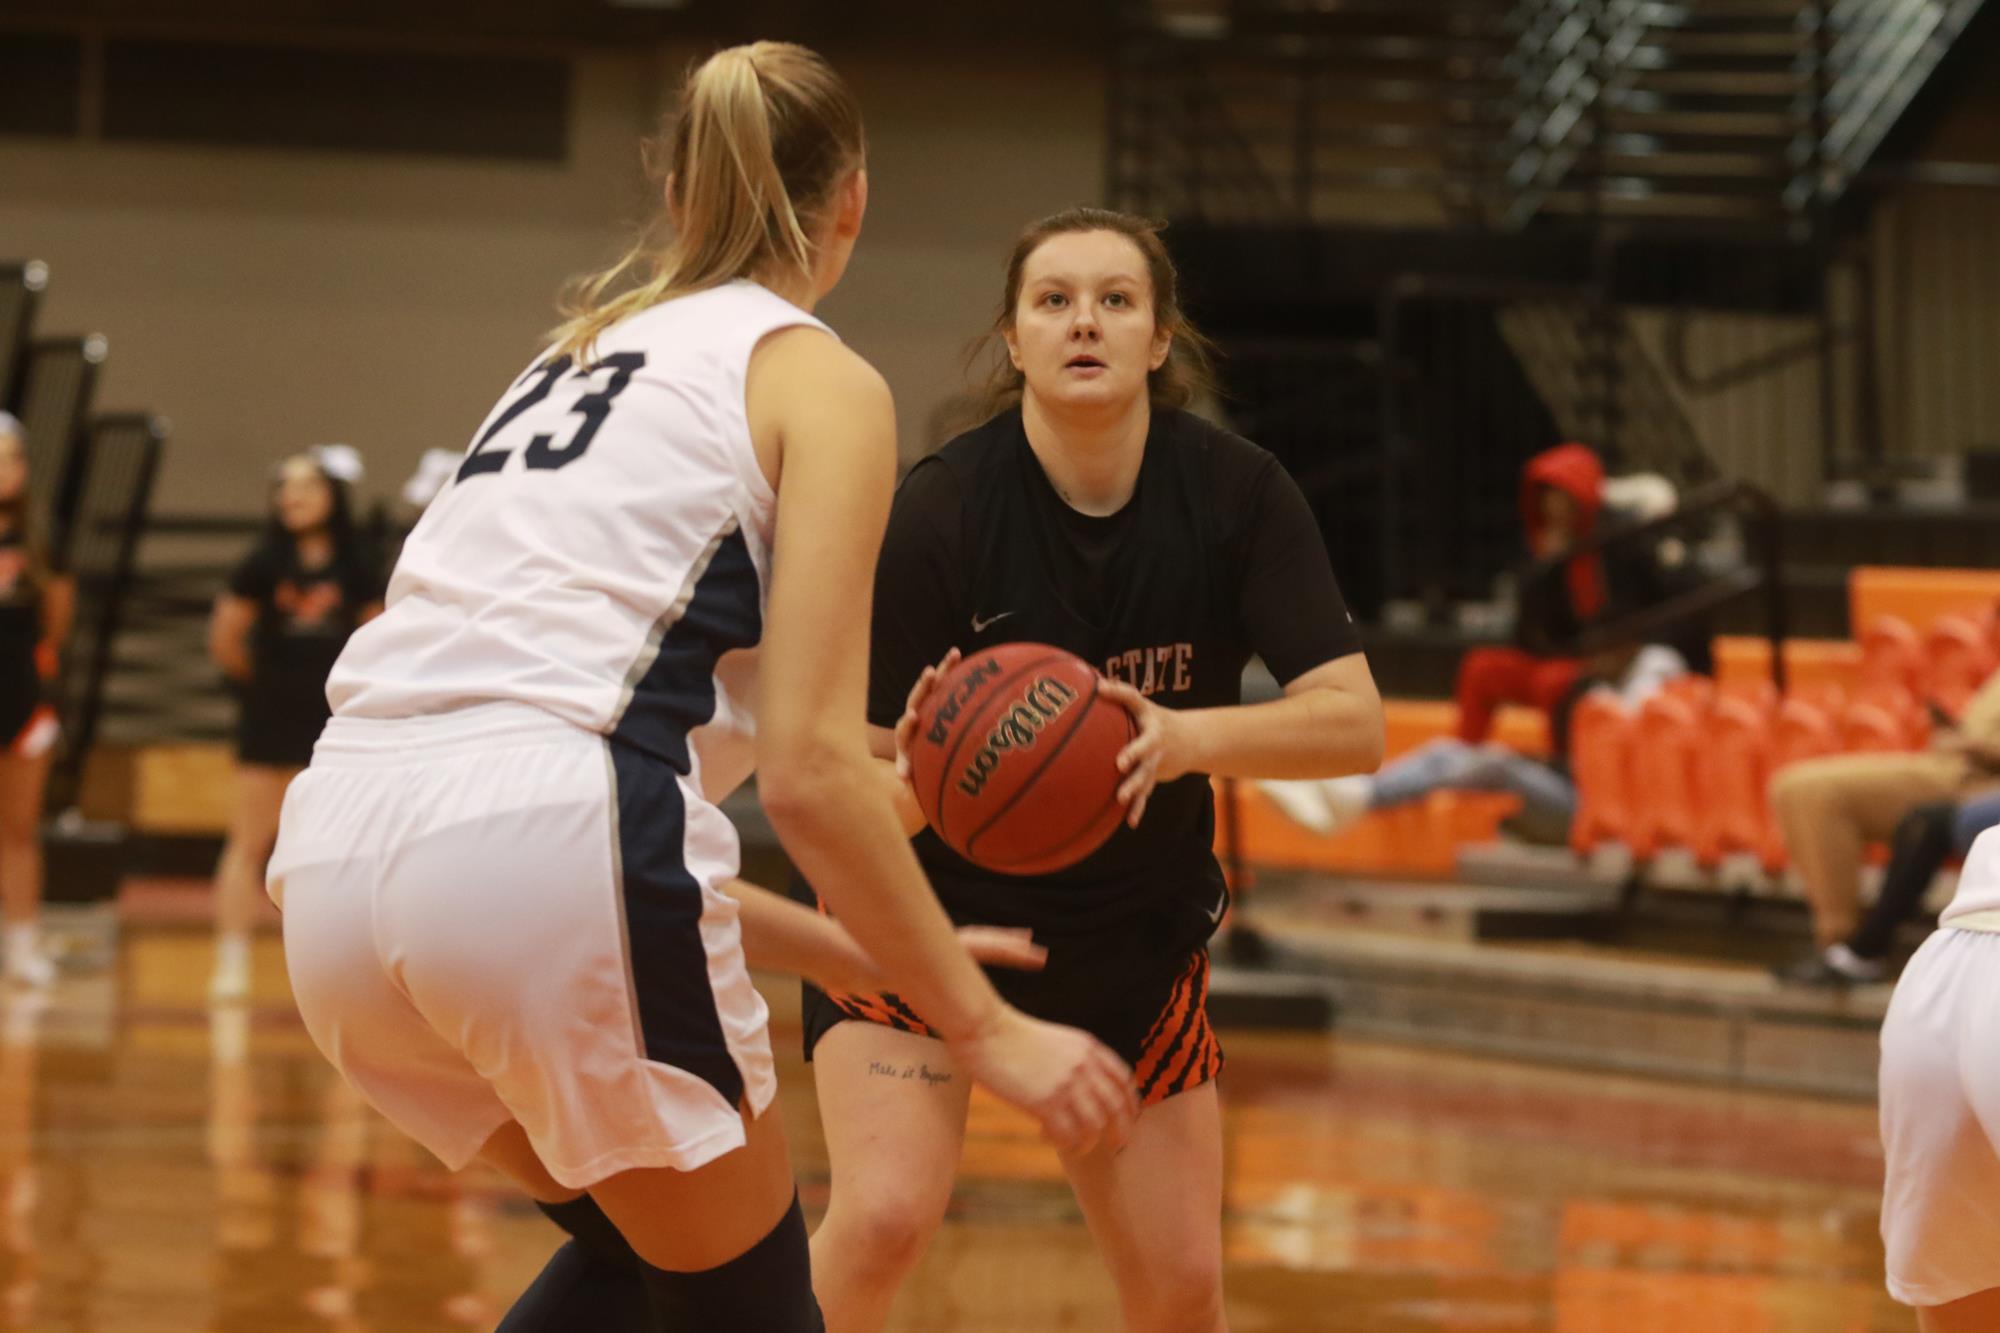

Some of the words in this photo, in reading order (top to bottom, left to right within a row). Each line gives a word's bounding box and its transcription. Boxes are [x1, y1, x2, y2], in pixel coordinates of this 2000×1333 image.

[454, 352, 646, 486] 23
[926, 658, 1003, 747] NCAA
[956, 676, 1079, 798] Wilson
